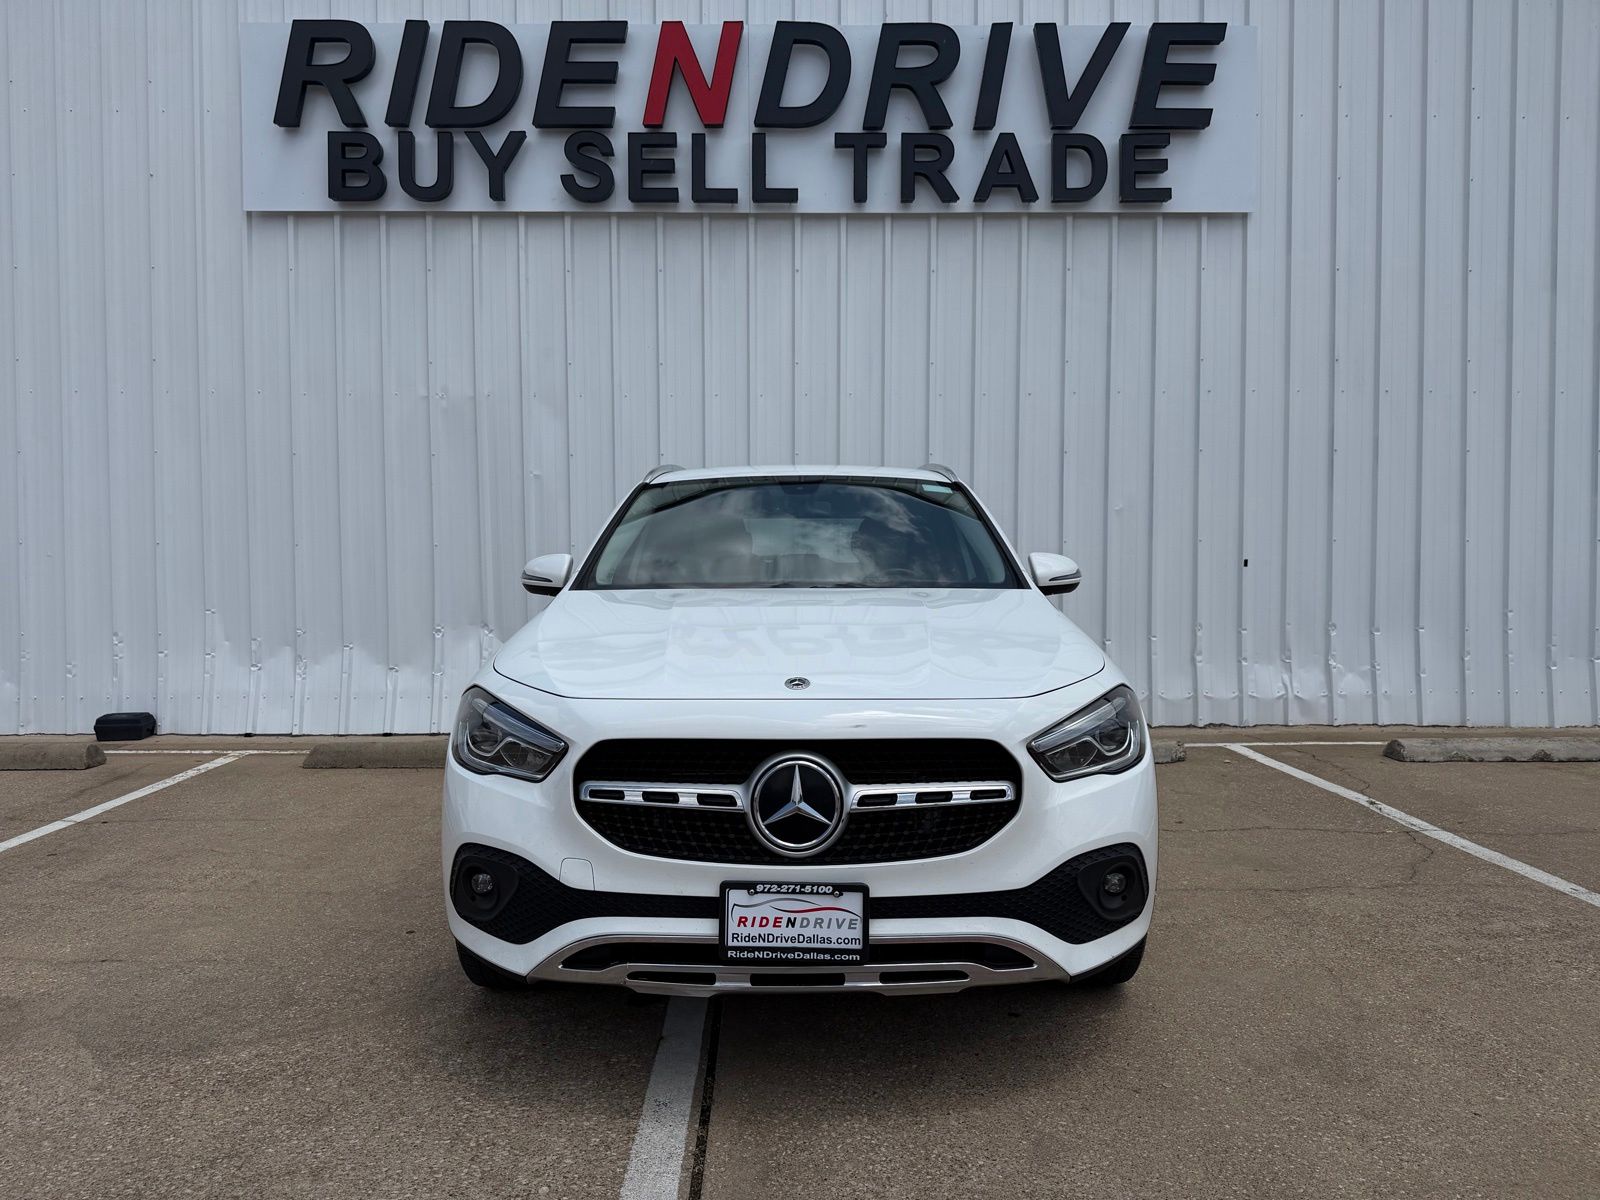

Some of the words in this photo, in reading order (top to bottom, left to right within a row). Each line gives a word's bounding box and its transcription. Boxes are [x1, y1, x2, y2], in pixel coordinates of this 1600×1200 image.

[273, 19, 1227, 130] RIDENDRIVE
[327, 130, 527, 202] BUY
[560, 130, 799, 203] SELL
[834, 132, 1172, 204] TRADE
[756, 884, 833, 894] 972-271-5100
[737, 916, 859, 930] RIDENDRIVE
[731, 932, 861, 946] RideNDriveDallas.com
[727, 950, 860, 961] RideNDriveDallas.com
